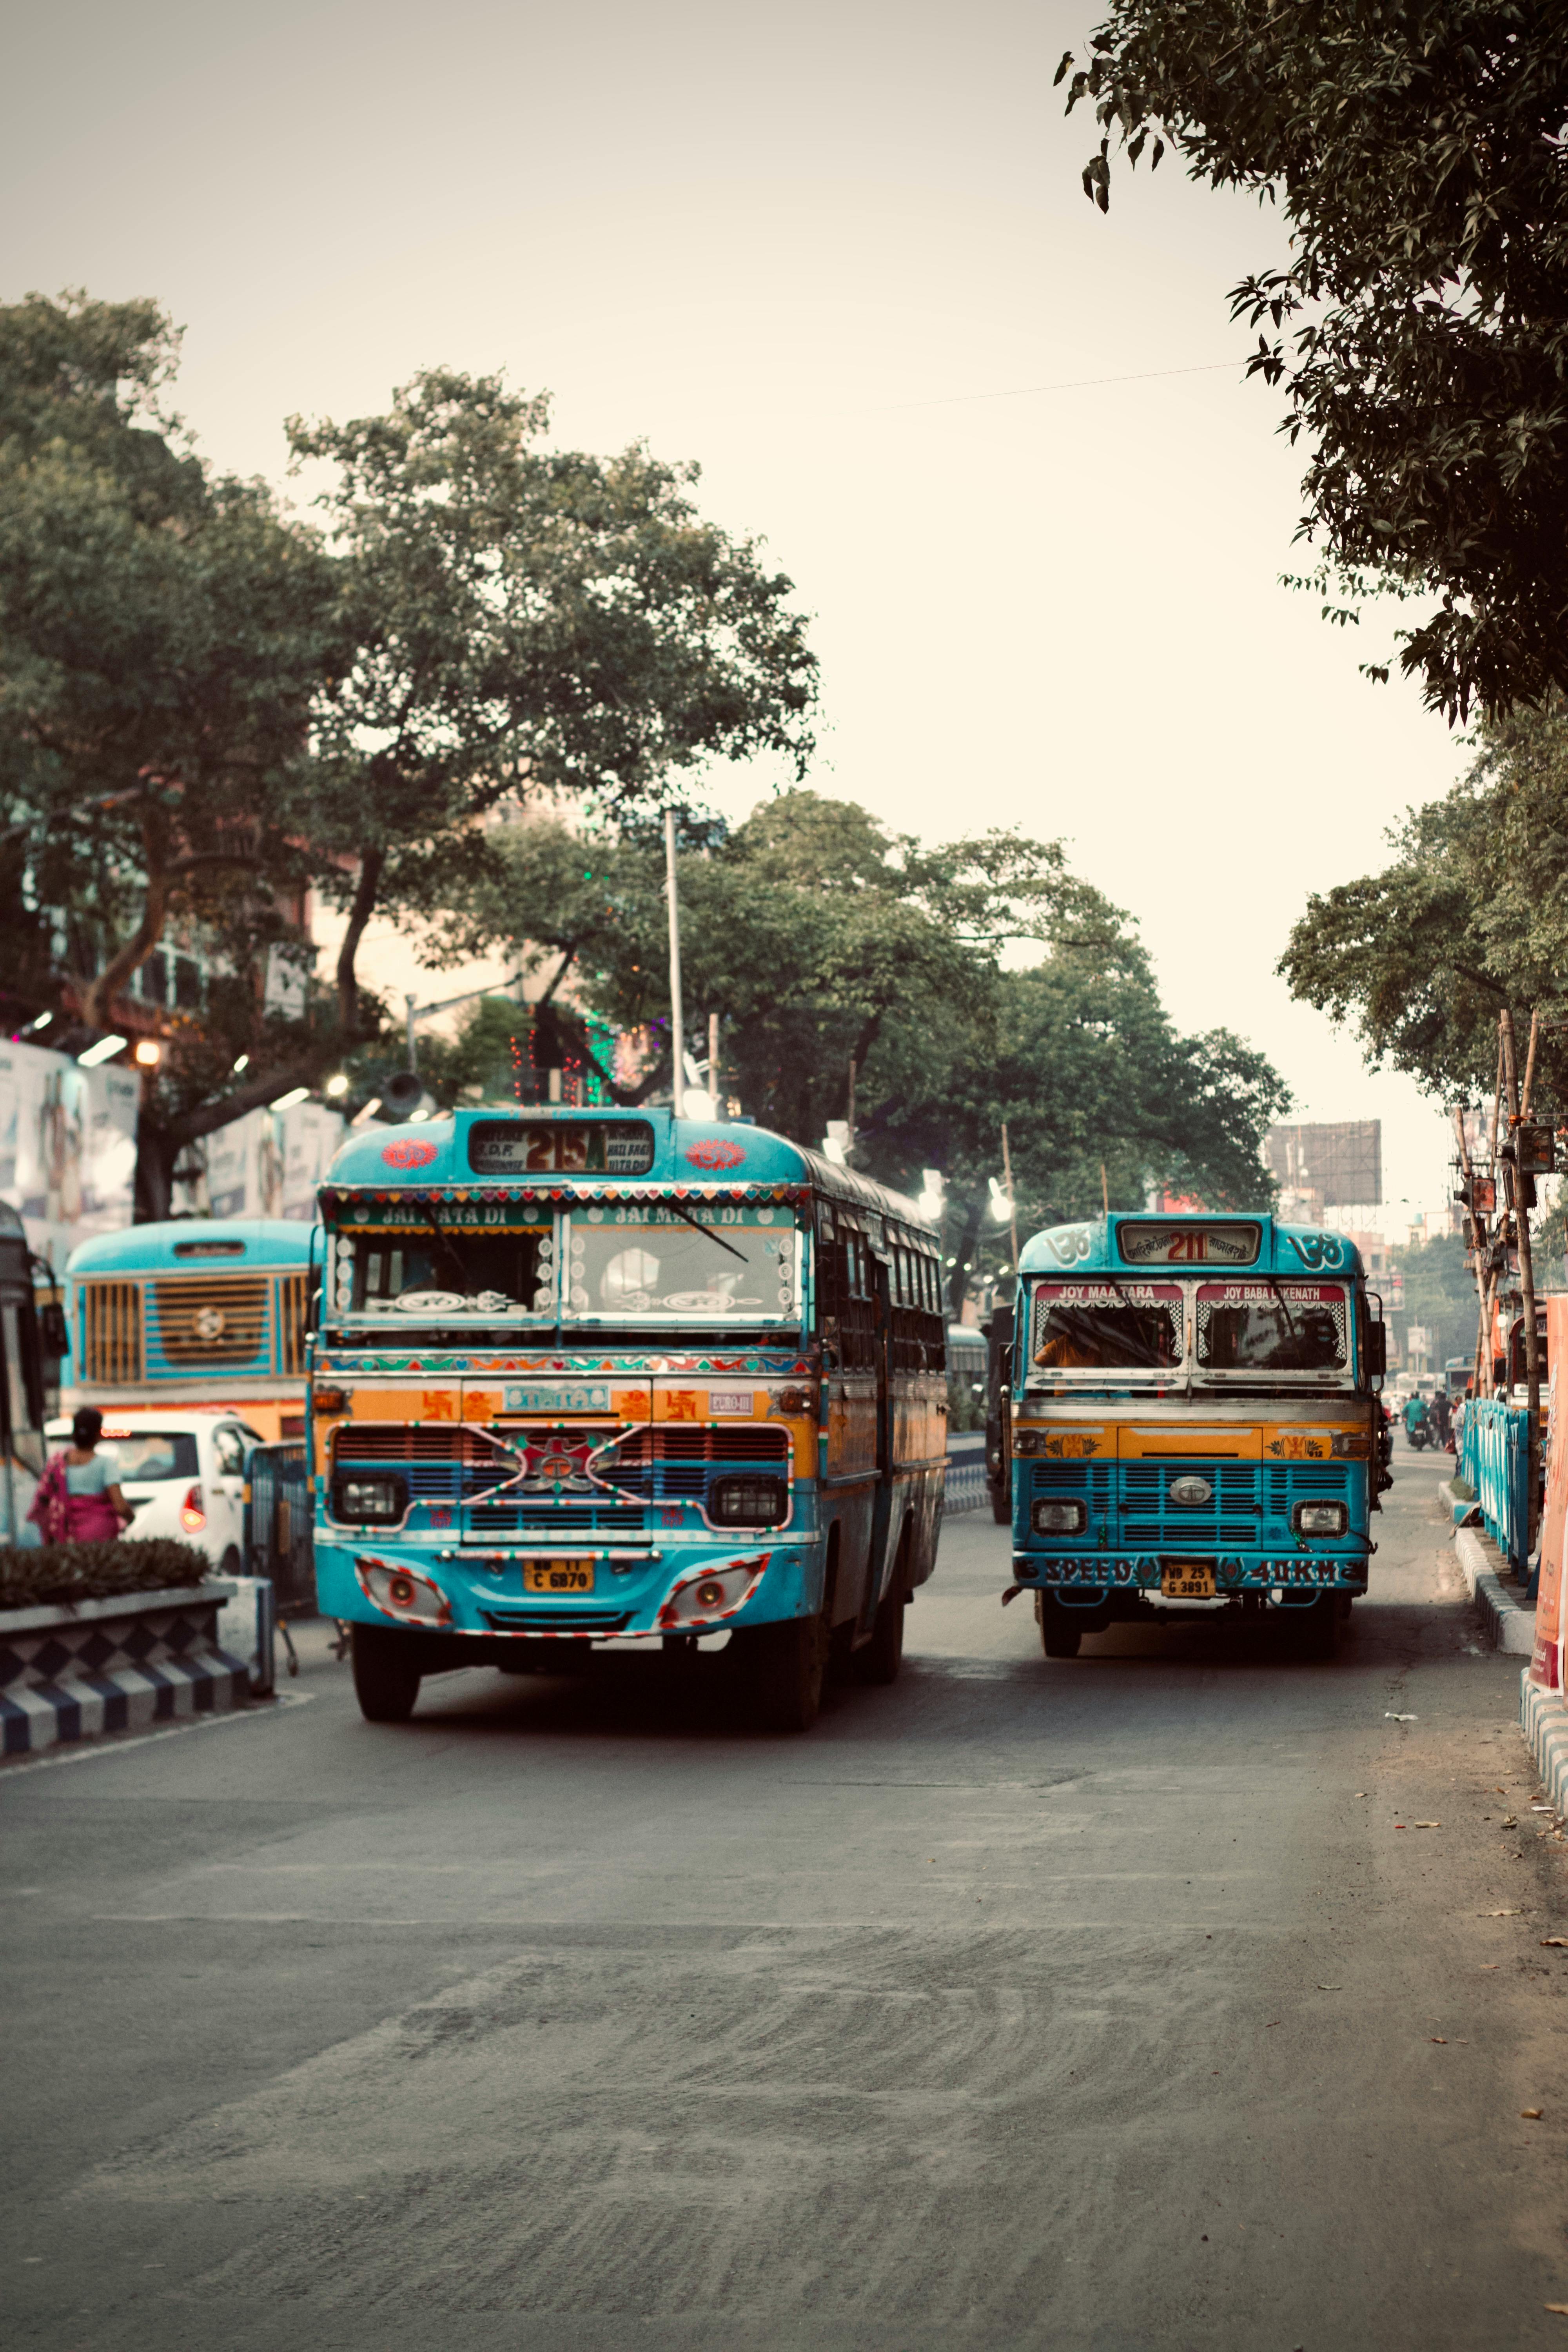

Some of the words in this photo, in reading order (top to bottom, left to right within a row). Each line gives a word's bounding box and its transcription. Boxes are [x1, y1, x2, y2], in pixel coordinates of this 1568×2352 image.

[382, 1207, 415, 1224] JAI
[484, 1207, 506, 1224] DI
[615, 1207, 650, 1224] JAI
[720, 1207, 744, 1224] DI
[1168, 1232, 1208, 1260] 211
[1059, 1286, 1084, 1299] JOY
[1088, 1286, 1117, 1299] MAA
[1223, 1287, 1241, 1299] JOY
[1244, 1287, 1269, 1299] BABA
[1045, 1559, 1133, 1584] SPEED
[1169, 1567, 1183, 1579] WB
[1191, 1567, 1205, 1579] 25
[534, 1573, 543, 1588] C
[1180, 1581, 1208, 1593] 3891
